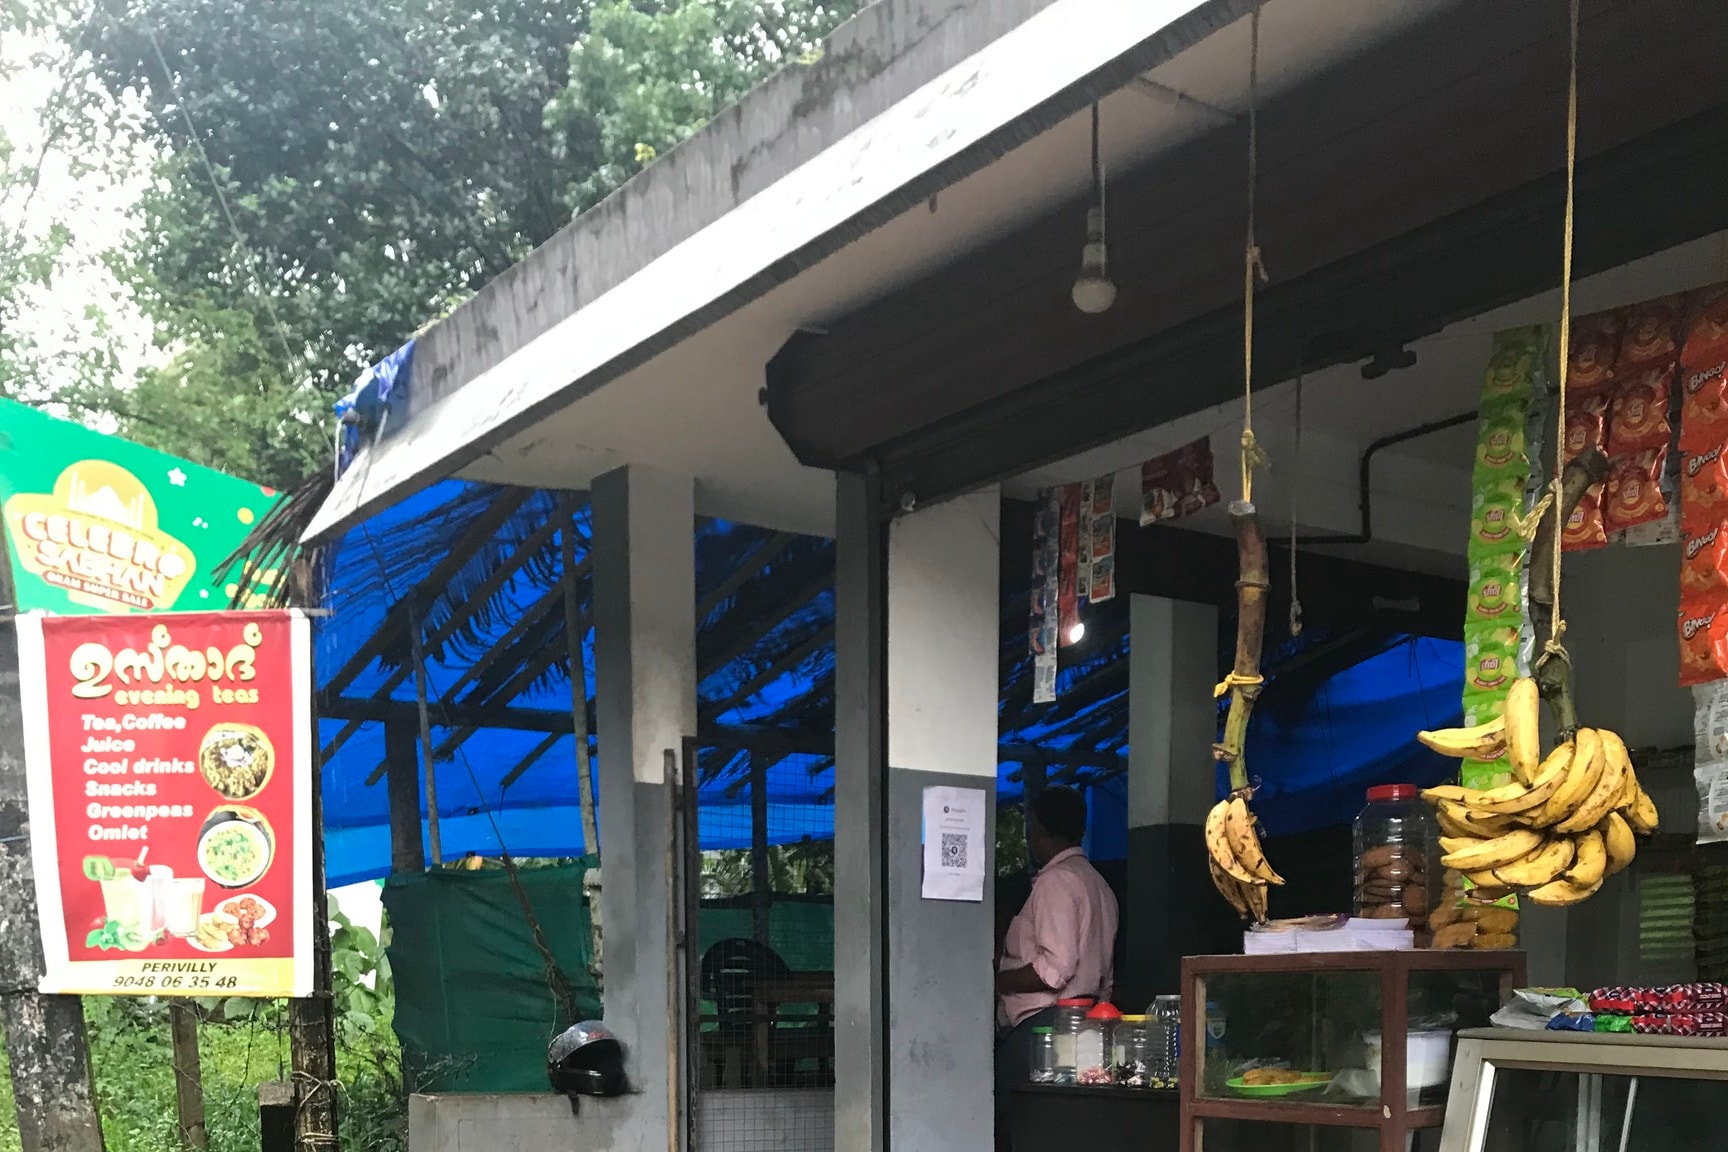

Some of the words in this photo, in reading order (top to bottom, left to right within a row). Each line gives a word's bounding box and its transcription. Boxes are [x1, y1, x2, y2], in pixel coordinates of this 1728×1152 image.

[115, 683, 200, 709] evening
[212, 685, 259, 704] teas
[81, 736, 136, 753] Juice
[83, 758, 129, 775] Cool
[133, 757, 195, 774] drinks
[85, 780, 157, 797] Snacks
[86, 802, 193, 821] Greenpeas
[88, 824, 148, 840] Omlet
[141, 962, 217, 973] PERIVILLY
[113, 976, 156, 988] 9048
[161, 976, 183, 988] 06
[188, 976, 211, 988] 35
[215, 976, 238, 989] 48
